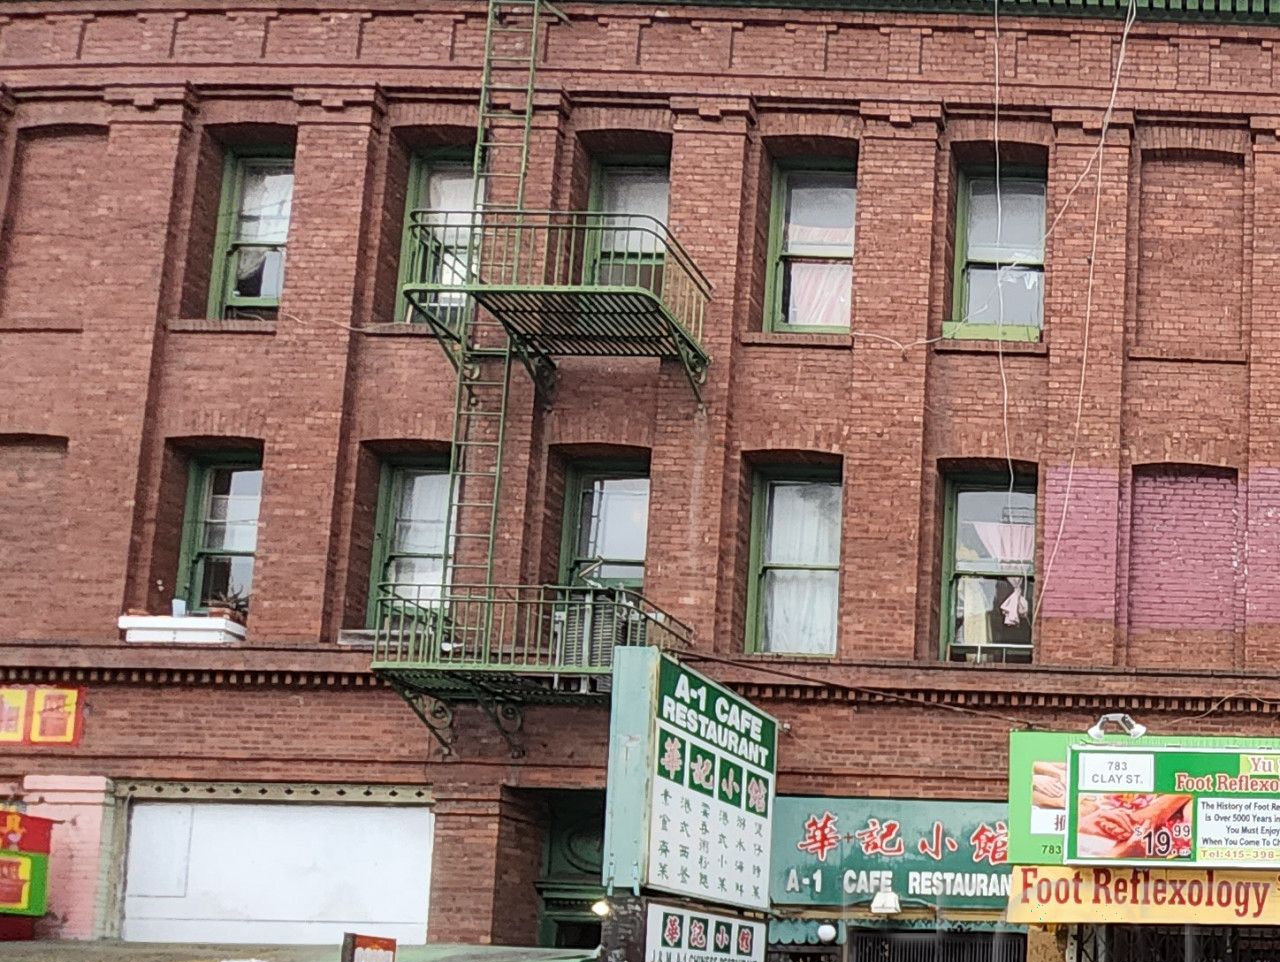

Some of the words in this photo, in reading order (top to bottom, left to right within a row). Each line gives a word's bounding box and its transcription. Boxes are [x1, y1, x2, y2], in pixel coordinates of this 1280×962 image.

[674, 673, 707, 712] A-1
[715, 696, 763, 742] CAFE
[662, 694, 769, 767] RESTAURANT
[1108, 761, 1128, 771] 783
[1092, 774, 1123, 784] CLAY
[1126, 774, 1143, 784] ST.
[1176, 773, 1212, 791] Foot
[1201, 802, 1215, 810] The
[1216, 802, 1242, 812] History
[1244, 802, 1252, 810] of
[1253, 803, 1269, 811] Foot
[1214, 813, 1231, 822] Over
[1232, 814, 1250, 822] 5000
[1252, 814, 1272, 823] Years
[1226, 826, 1240, 834] You
[1241, 826, 1258, 834] Must
[1261, 827, 1280, 836] Enjoy
[797, 810, 1009, 865] 華記小館
[1202, 838, 1222, 846] When
[1224, 838, 1238, 846] You
[1042, 845, 1062, 855] 783
[786, 868, 822, 893] A-1
[843, 868, 893, 894] CAFE
[908, 871, 1011, 897] RESTAURAN
[1020, 867, 1083, 905] Foot
[1092, 868, 1270, 918] Reflexology
